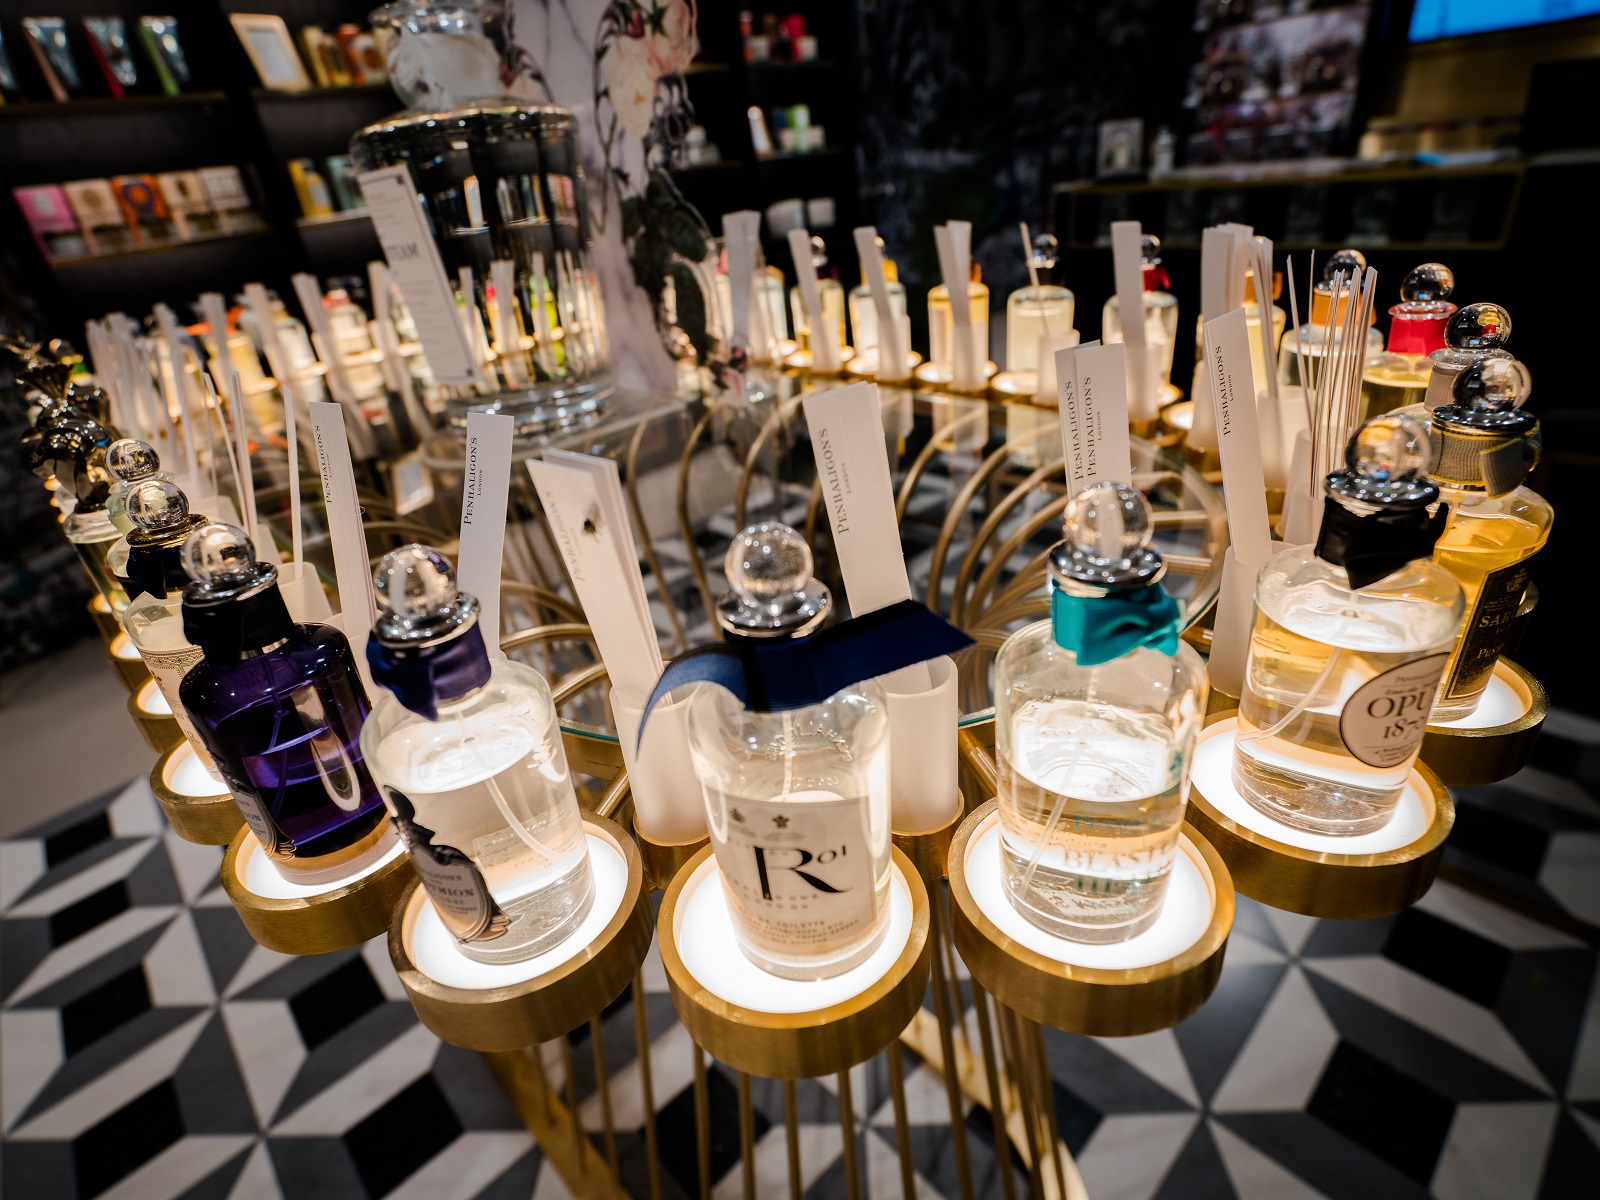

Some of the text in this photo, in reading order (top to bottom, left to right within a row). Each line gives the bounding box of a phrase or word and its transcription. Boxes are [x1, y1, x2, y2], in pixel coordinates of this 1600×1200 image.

[1064, 381, 1084, 481] PENHALIGON'S
[1083, 377, 1097, 477] PENHALIGON'S
[1215, 345, 1231, 436] PENHALIGON'S
[463, 437, 478, 525] PENHALIGON'S
[819, 428, 849, 534] PENHALIGON'S
